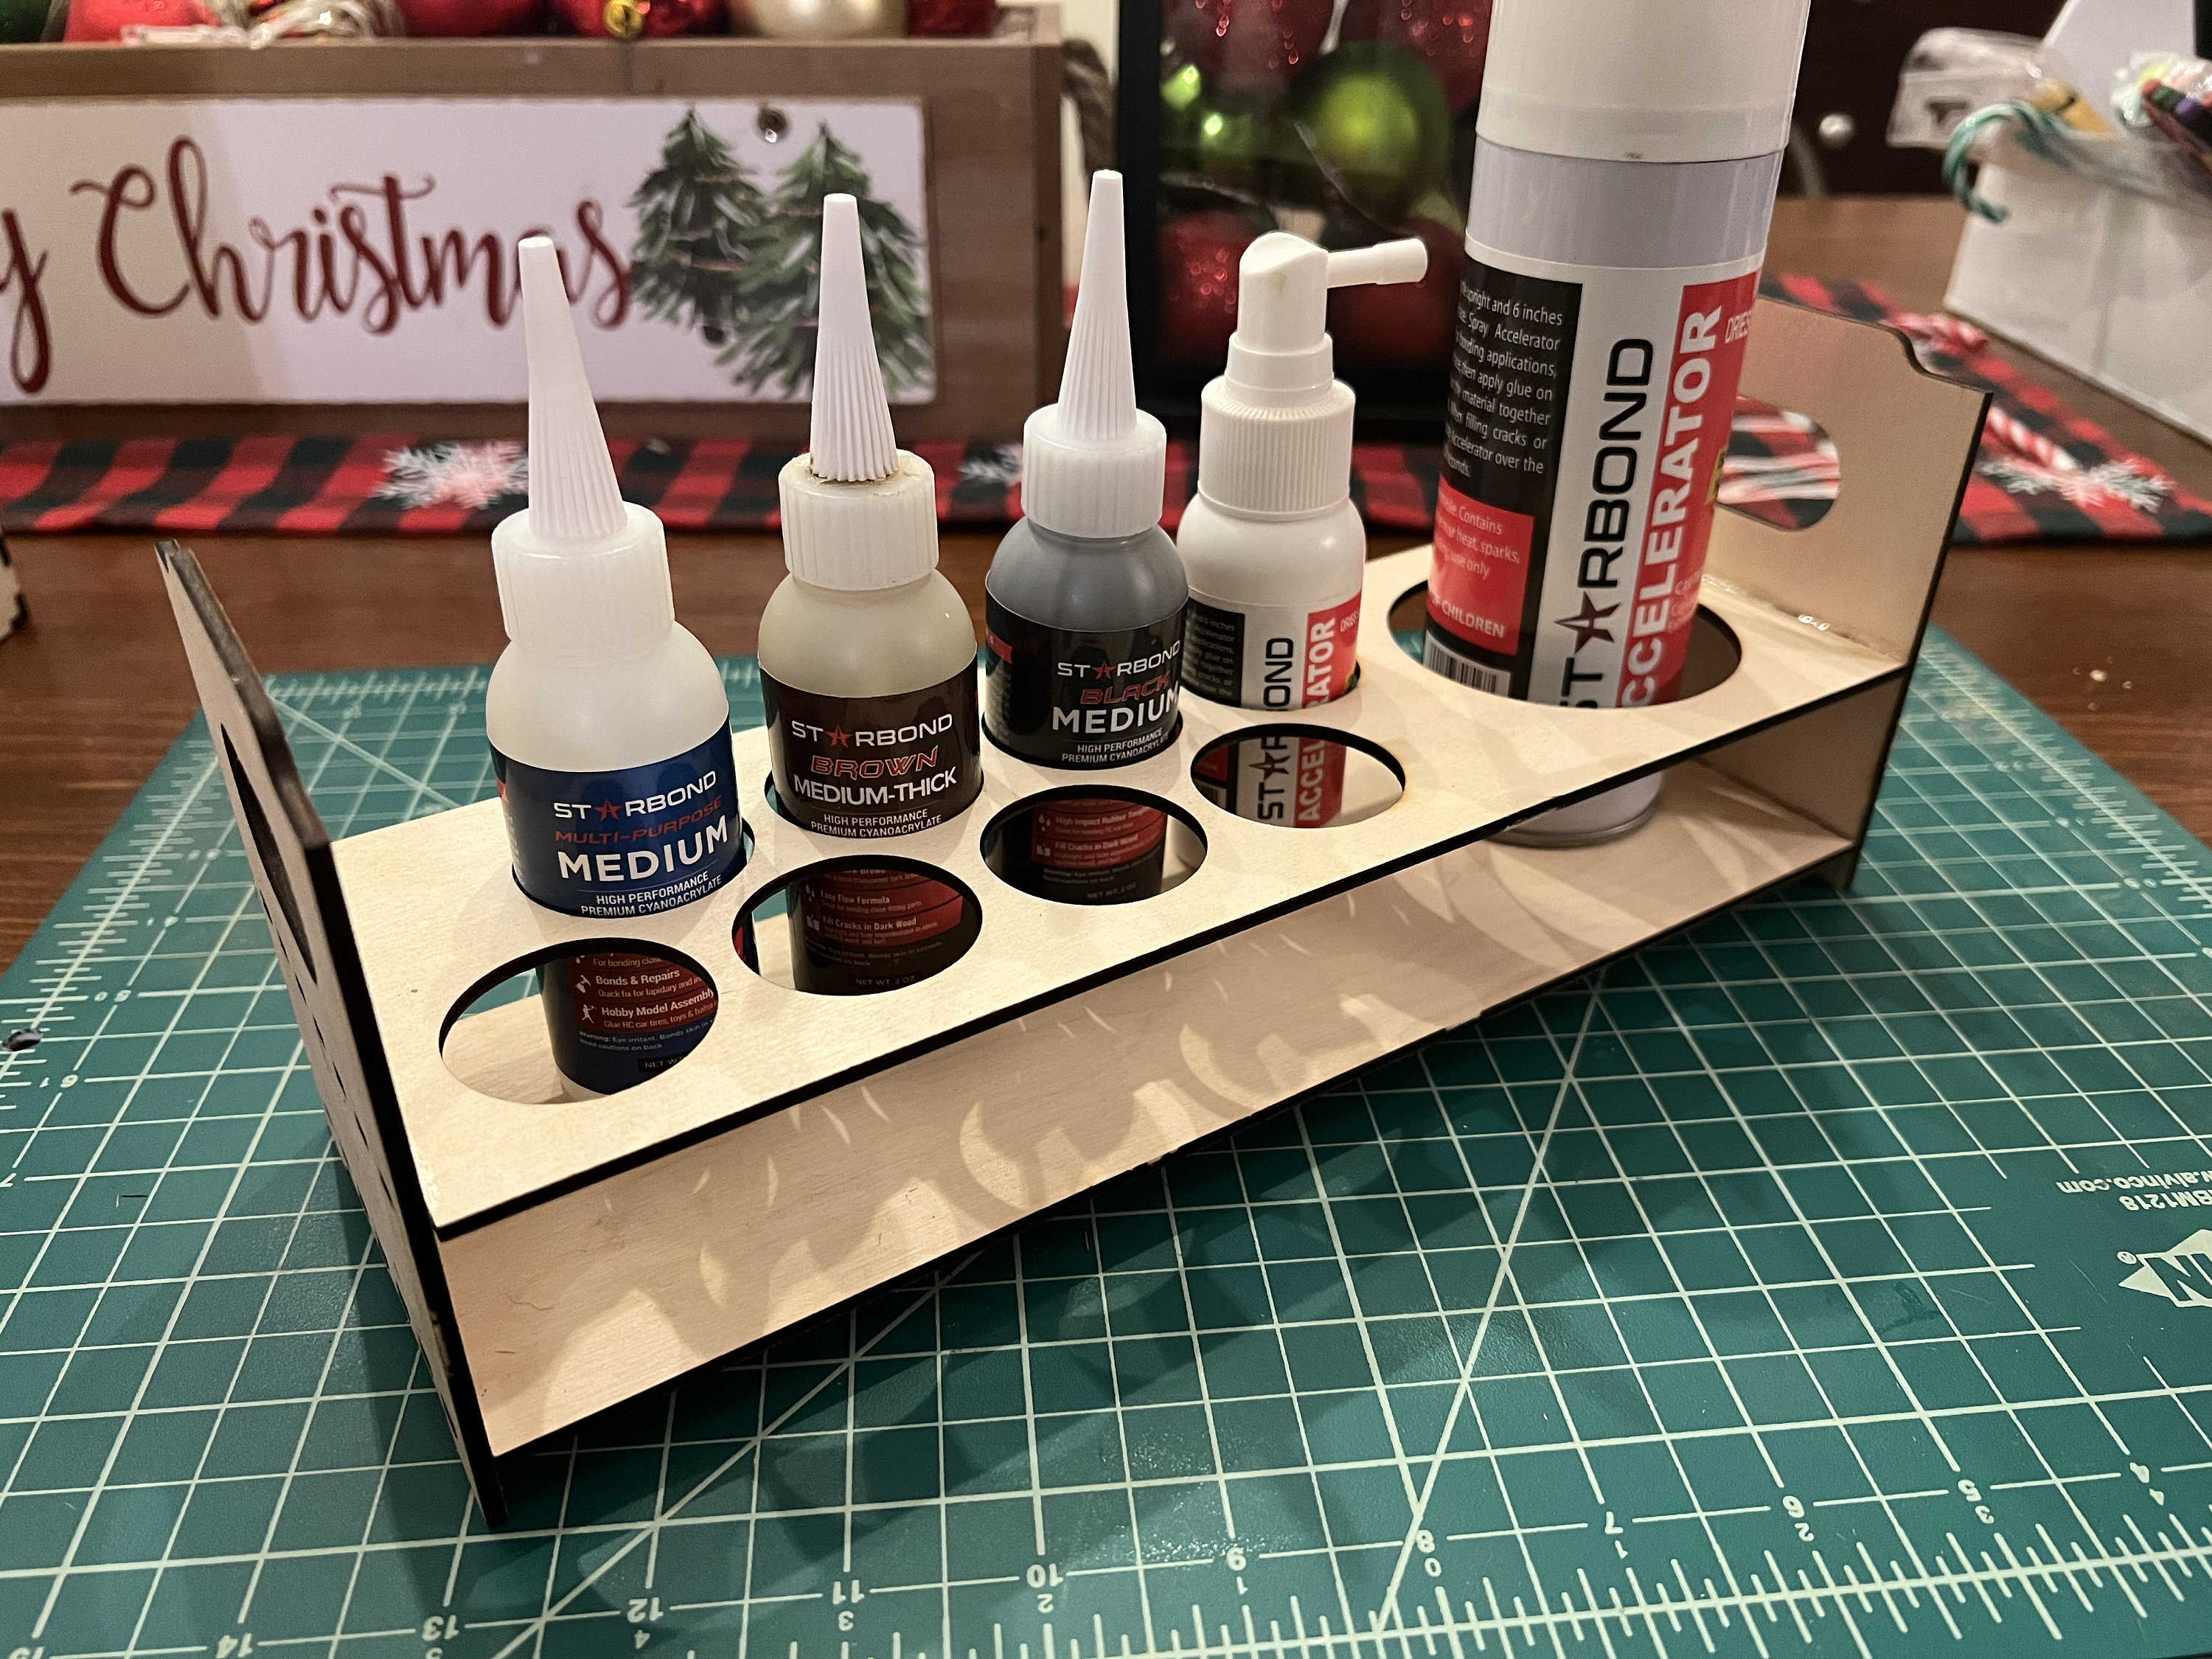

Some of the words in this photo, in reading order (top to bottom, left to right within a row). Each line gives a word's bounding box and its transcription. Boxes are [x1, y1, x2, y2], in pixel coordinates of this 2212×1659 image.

[1492, 299, 1510, 316] and
[1512, 302, 1520, 319] 6
[1523, 303, 1563, 327] inches
[1467, 312, 1489, 338] Spray
[1494, 323, 1561, 352] Accelerator
[1486, 349, 1557, 379] applications,
[1477, 371, 1503, 394] apply
[1506, 379, 1533, 398] glue
[1536, 388, 1553, 402] on
[1461, 389, 1495, 414] material
[1499, 402, 1551, 426] together
[1492, 426, 1527, 448] cracks
[1533, 437, 1548, 451] or
[1495, 452, 1520, 470] over
[1523, 456, 1544, 476] the
[1623, 305, 1722, 707] CCELERATOR
[1458, 506, 1503, 535] Contains
[1554, 338, 1653, 707] TARBOND
[1467, 559, 1490, 580] only
[1442, 599, 1506, 639] CHILDREN
[1080, 669, 1170, 705] BLACK
[1052, 681, 1180, 734] MEDIUM
[1077, 742, 1102, 754] HIGH
[1104, 727, 1163, 752] PERFORMANCE
[811, 745, 939, 781] BROWN
[1062, 754, 1107, 763] PREMIUM
[793, 766, 957, 806] MEDIUM-THICK
[554, 795, 723, 844] MULTI-PURPOSE
[811, 821, 858, 838] PREMIUM
[859, 814, 942, 838] CYANOACRYLATE
[824, 813, 849, 826] HIGH
[852, 808, 928, 827] PERFORMANCE
[557, 815, 728, 882] MEDIUM
[580, 905, 636, 916] PREMIUM
[639, 874, 723, 914] CYANOACRYLATE
[596, 894, 626, 905] HIGH
[628, 871, 709, 903] PERFORMANCE
[838, 894, 856, 903] Flow
[857, 895, 891, 905] Formula
[835, 919, 863, 931] Cracks
[863, 922, 872, 931] in
[874, 921, 894, 931] Dark
[895, 917, 917, 928] Wood
[593, 958, 606, 967] For
[607, 957, 641, 969] bonding
[594, 975, 629, 987] Bonds
[630, 975, 639, 986] &
[640, 968, 681, 985] Repairs
[597, 988, 621, 998] Quick
[645, 982, 678, 997] lapidary
[678, 977, 693, 990] and
[855, 978, 874, 986] NET
[601, 1006, 635, 1020] Hobby
[636, 1001, 669, 1017] Model
[669, 987, 715, 1011] Assembly
[602, 1019, 622, 1029] Glue
[622, 1019, 635, 1029] RC
[635, 1020, 648, 1029] car
[669, 1010, 686, 1023] toys
[686, 1009, 695, 1018] &
[643, 1042, 663, 1051] back
[644, 1059, 665, 1069] NET
[2118, 1189, 2212, 1211] BM1218
[1958, 1479, 1982, 1502] 5
[1604, 1511, 1624, 1534] 7
[1975, 1505, 1994, 1524] 3
[1415, 1528, 1436, 1553] 8
[1794, 1522, 1815, 1542] 2
[1615, 1540, 1629, 1559] 1
[1026, 1562, 1063, 1588] 10
[1424, 1557, 1441, 1577] 0
[832, 1580, 865, 1605] 11
[1237, 1576, 1250, 1596] 1
[627, 1596, 663, 1623] 12
[1037, 1593, 1054, 1613] 2
[422, 1615, 460, 1641] 13
[838, 1610, 855, 1631] 3
[217, 1632, 253, 1659] 14
[634, 1629, 650, 1649] 4
